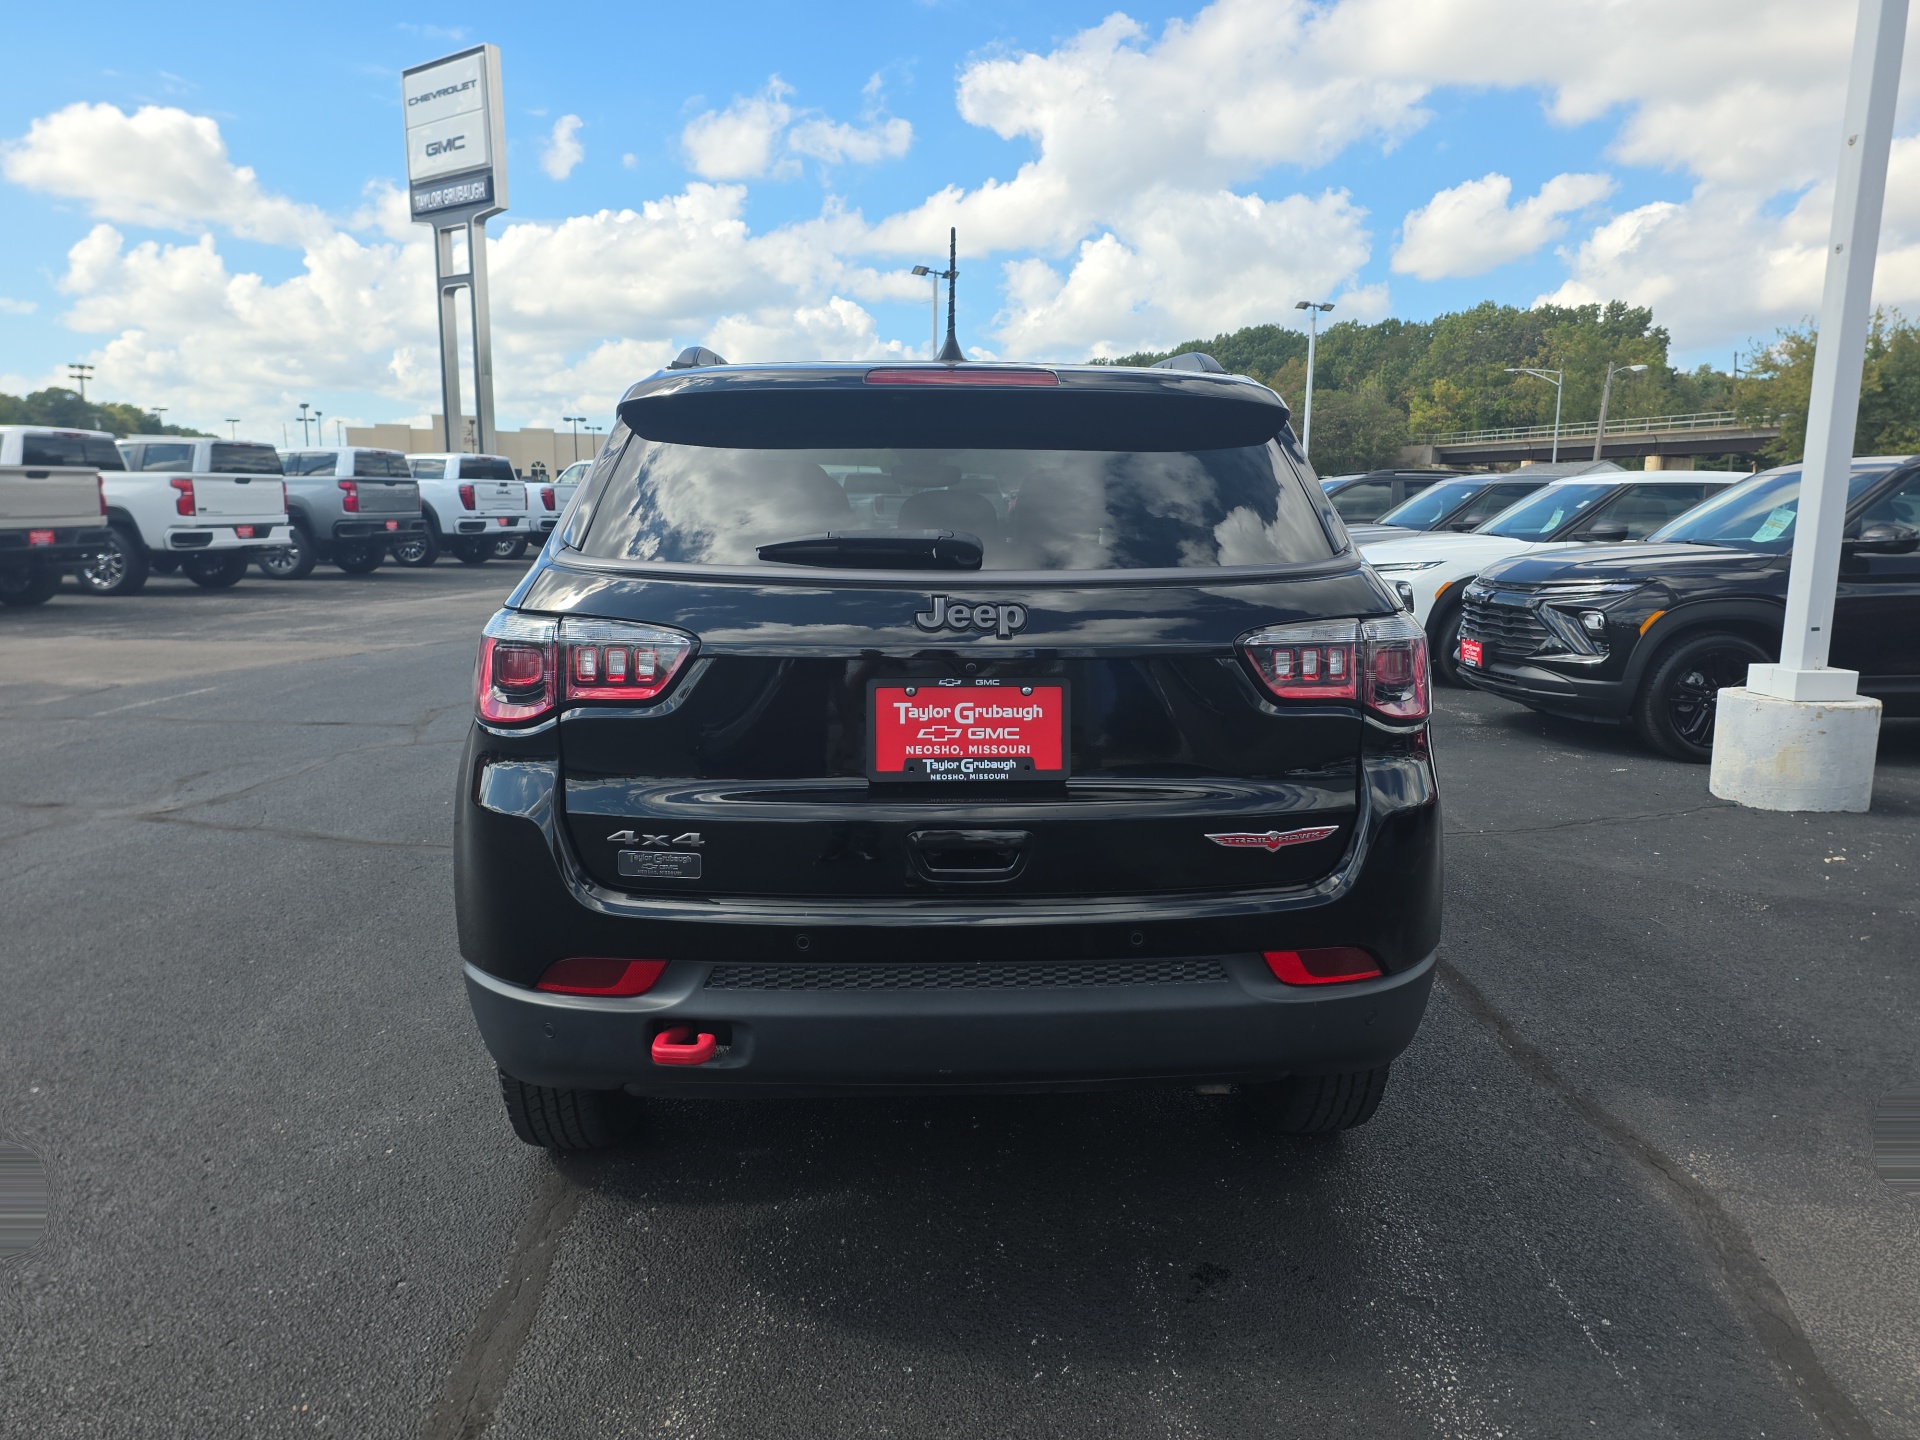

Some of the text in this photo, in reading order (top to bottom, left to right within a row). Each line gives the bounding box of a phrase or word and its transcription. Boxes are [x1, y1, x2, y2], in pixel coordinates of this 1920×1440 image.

[408, 79, 477, 106] CHEVROLET
[425, 135, 465, 157] GMC
[415, 182, 486, 211] TAYLOR GRUBAUGH
[915, 595, 1027, 640] Jeep
[893, 702, 1043, 724] Taylor Grubaugh
[967, 727, 1020, 739] GMC
[905, 745, 1031, 756] NEOSHO, MISSOURI
[922, 758, 1017, 773] Taylor Grubaugh
[930, 773, 967, 781] NEOSHO,
[627, 852, 653, 863] Taylor
